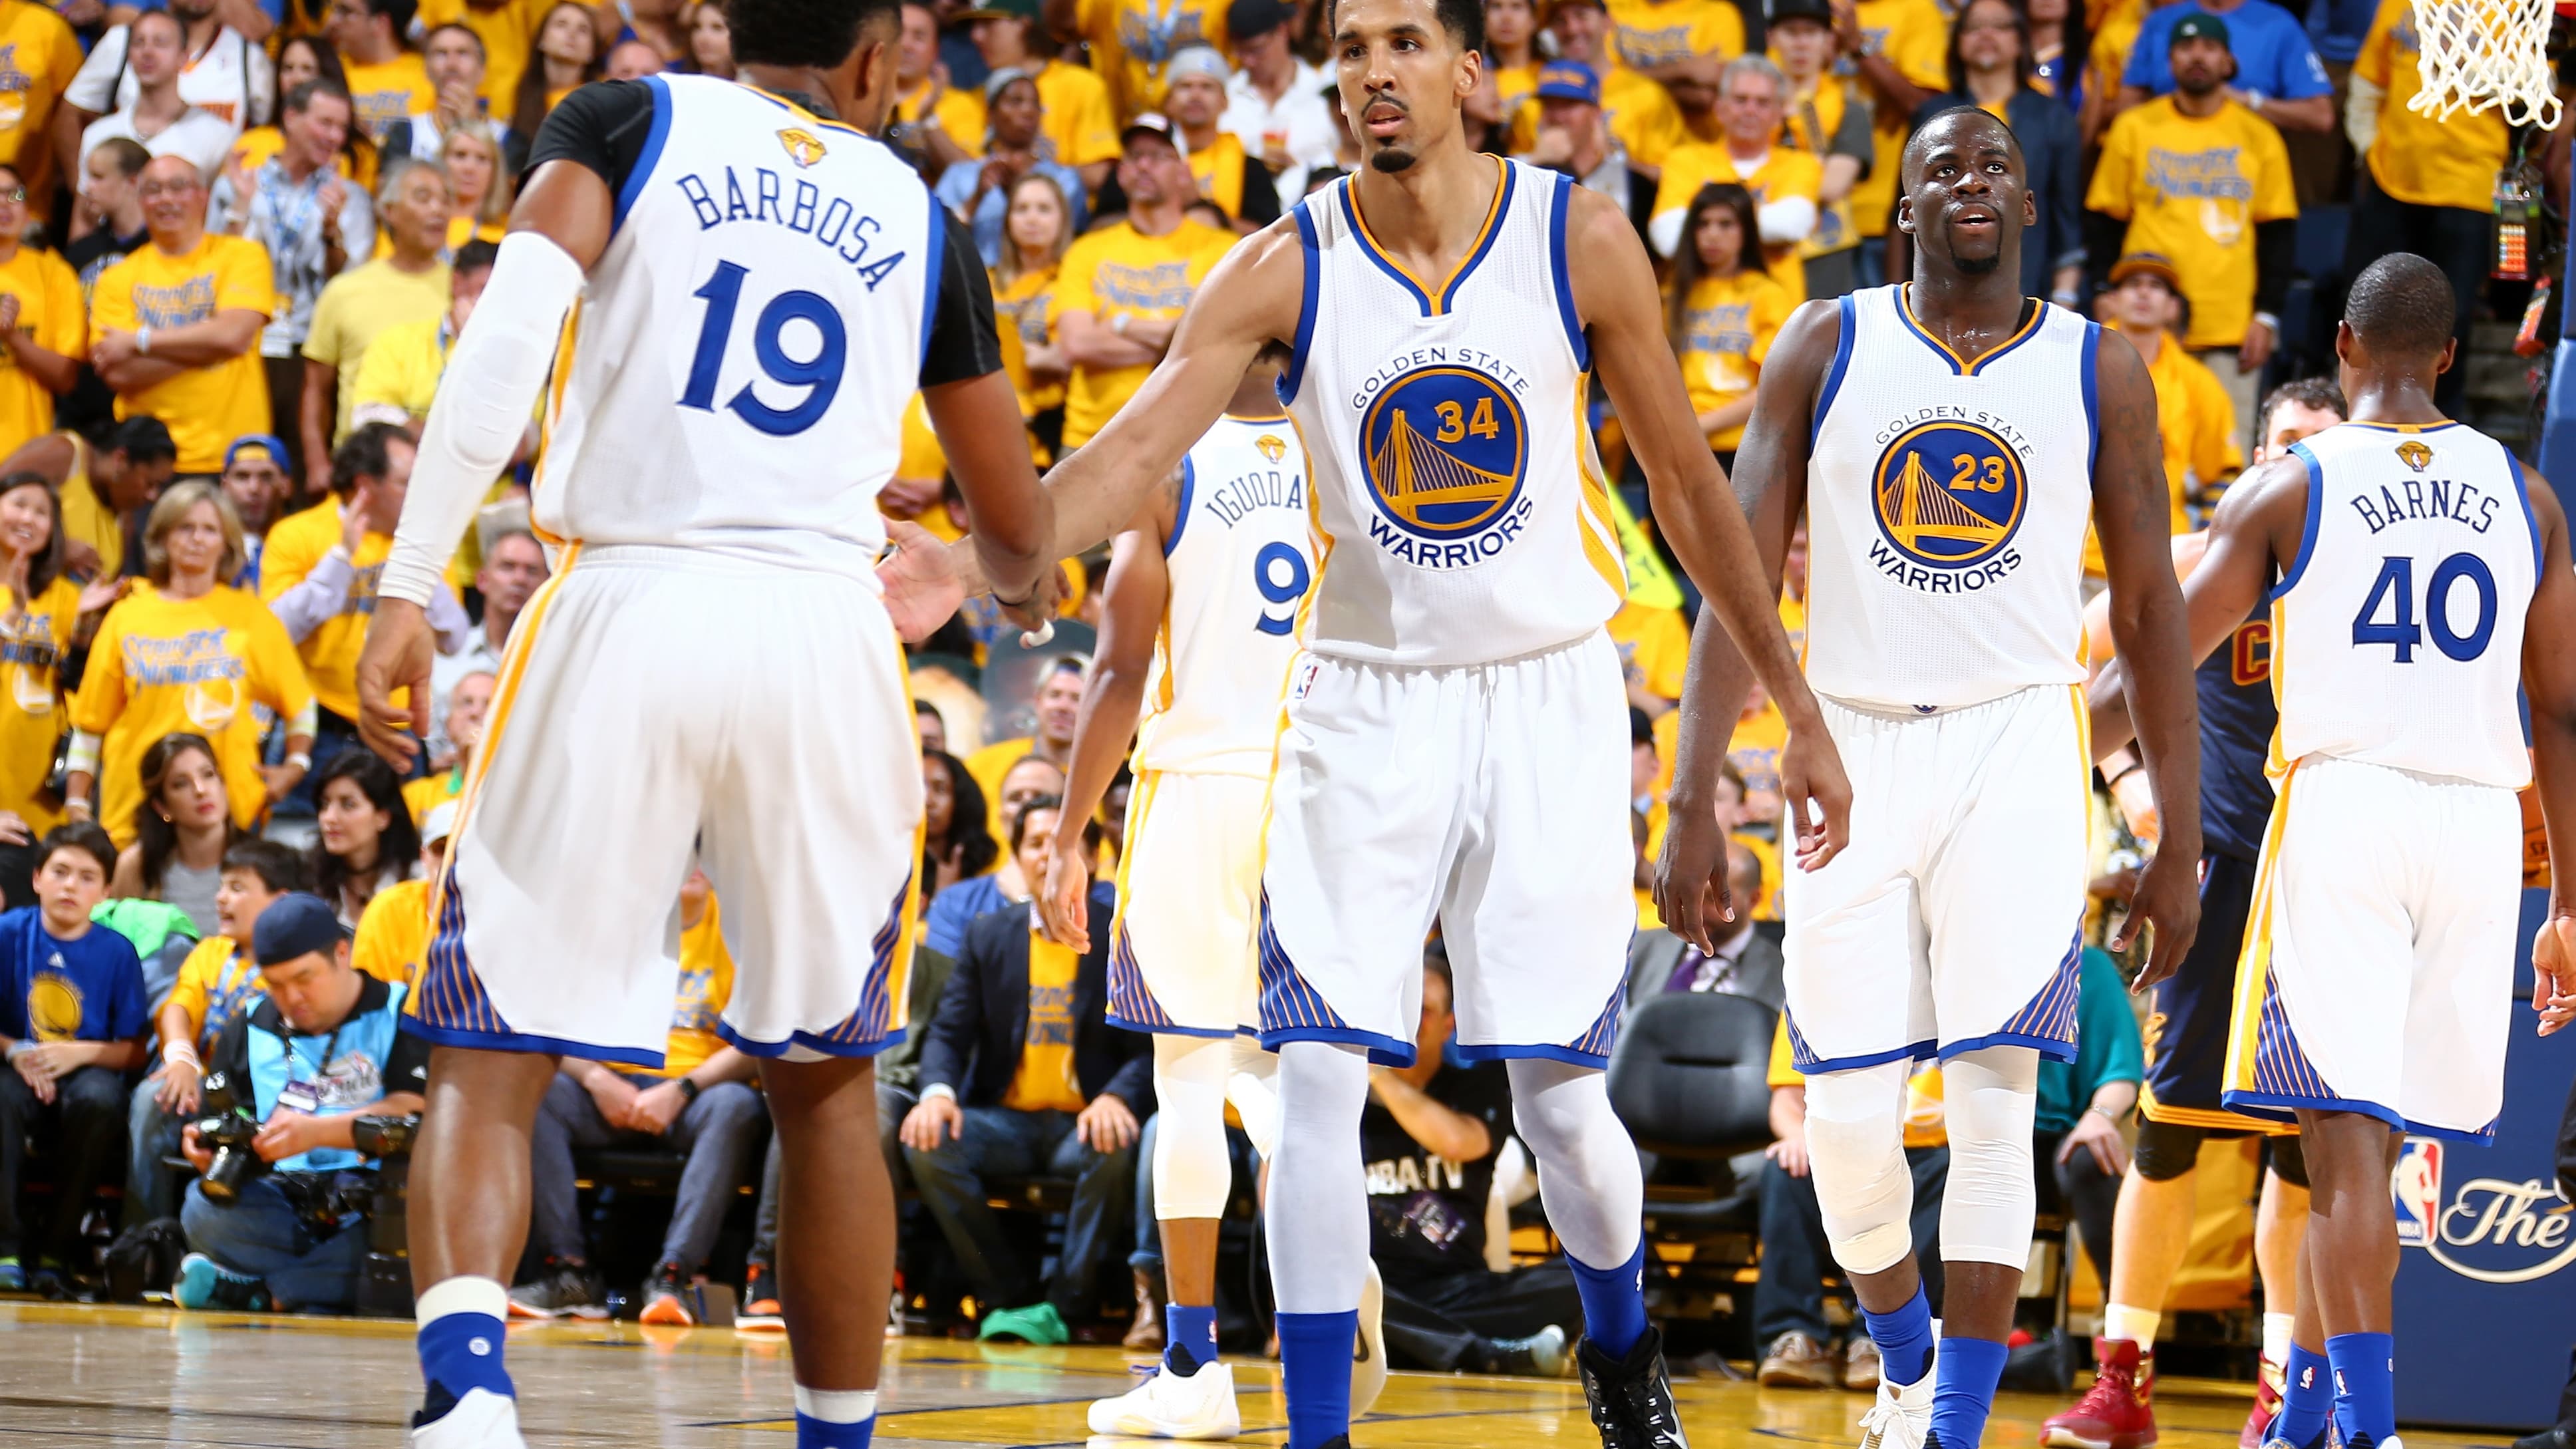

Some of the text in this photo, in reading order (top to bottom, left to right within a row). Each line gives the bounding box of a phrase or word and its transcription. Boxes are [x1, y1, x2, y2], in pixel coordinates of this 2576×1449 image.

[675, 166, 905, 291] BARBOSA
[675, 259, 846, 437] 19
[1353, 347, 1529, 409] GOLDEN STATE
[1434, 397, 1500, 443] 34
[1875, 406, 2034, 458] GOLDEN STATE
[1948, 453, 2007, 493] 23
[1368, 496, 1533, 568] WARRIORS
[2350, 480, 2500, 534] BARNES
[1253, 541, 1310, 637] 9
[1868, 538, 2022, 593] WARRIORS
[2352, 552, 2498, 663] 40
[1426, 1154, 1463, 1190] TV
[2440, 1178, 2570, 1248] The
